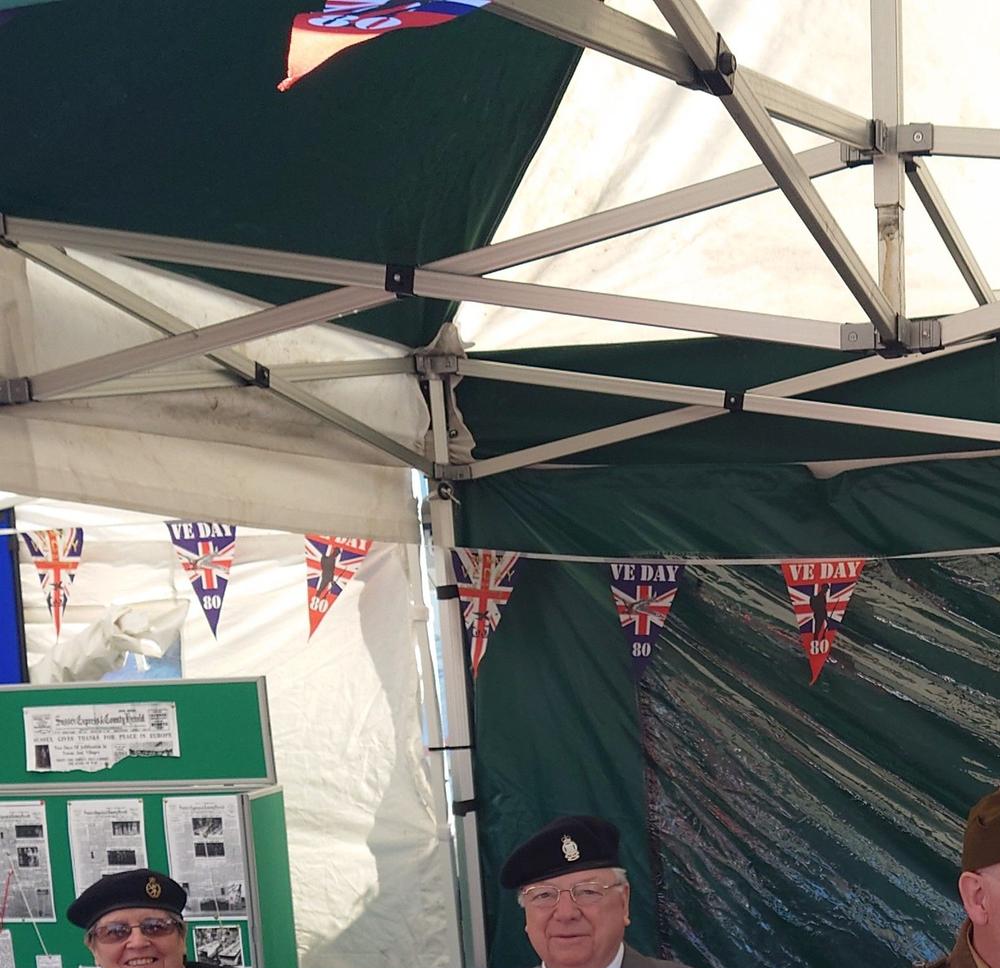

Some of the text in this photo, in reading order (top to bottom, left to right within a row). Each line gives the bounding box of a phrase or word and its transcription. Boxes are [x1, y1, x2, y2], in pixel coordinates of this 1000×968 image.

[171, 522, 232, 540] VE DAY
[611, 564, 679, 581] VE DAY
[789, 562, 861, 580] VE DAY
[203, 595, 221, 610] 80
[310, 596, 328, 613] 80
[632, 642, 651, 657] 80
[810, 640, 830, 655] 80
